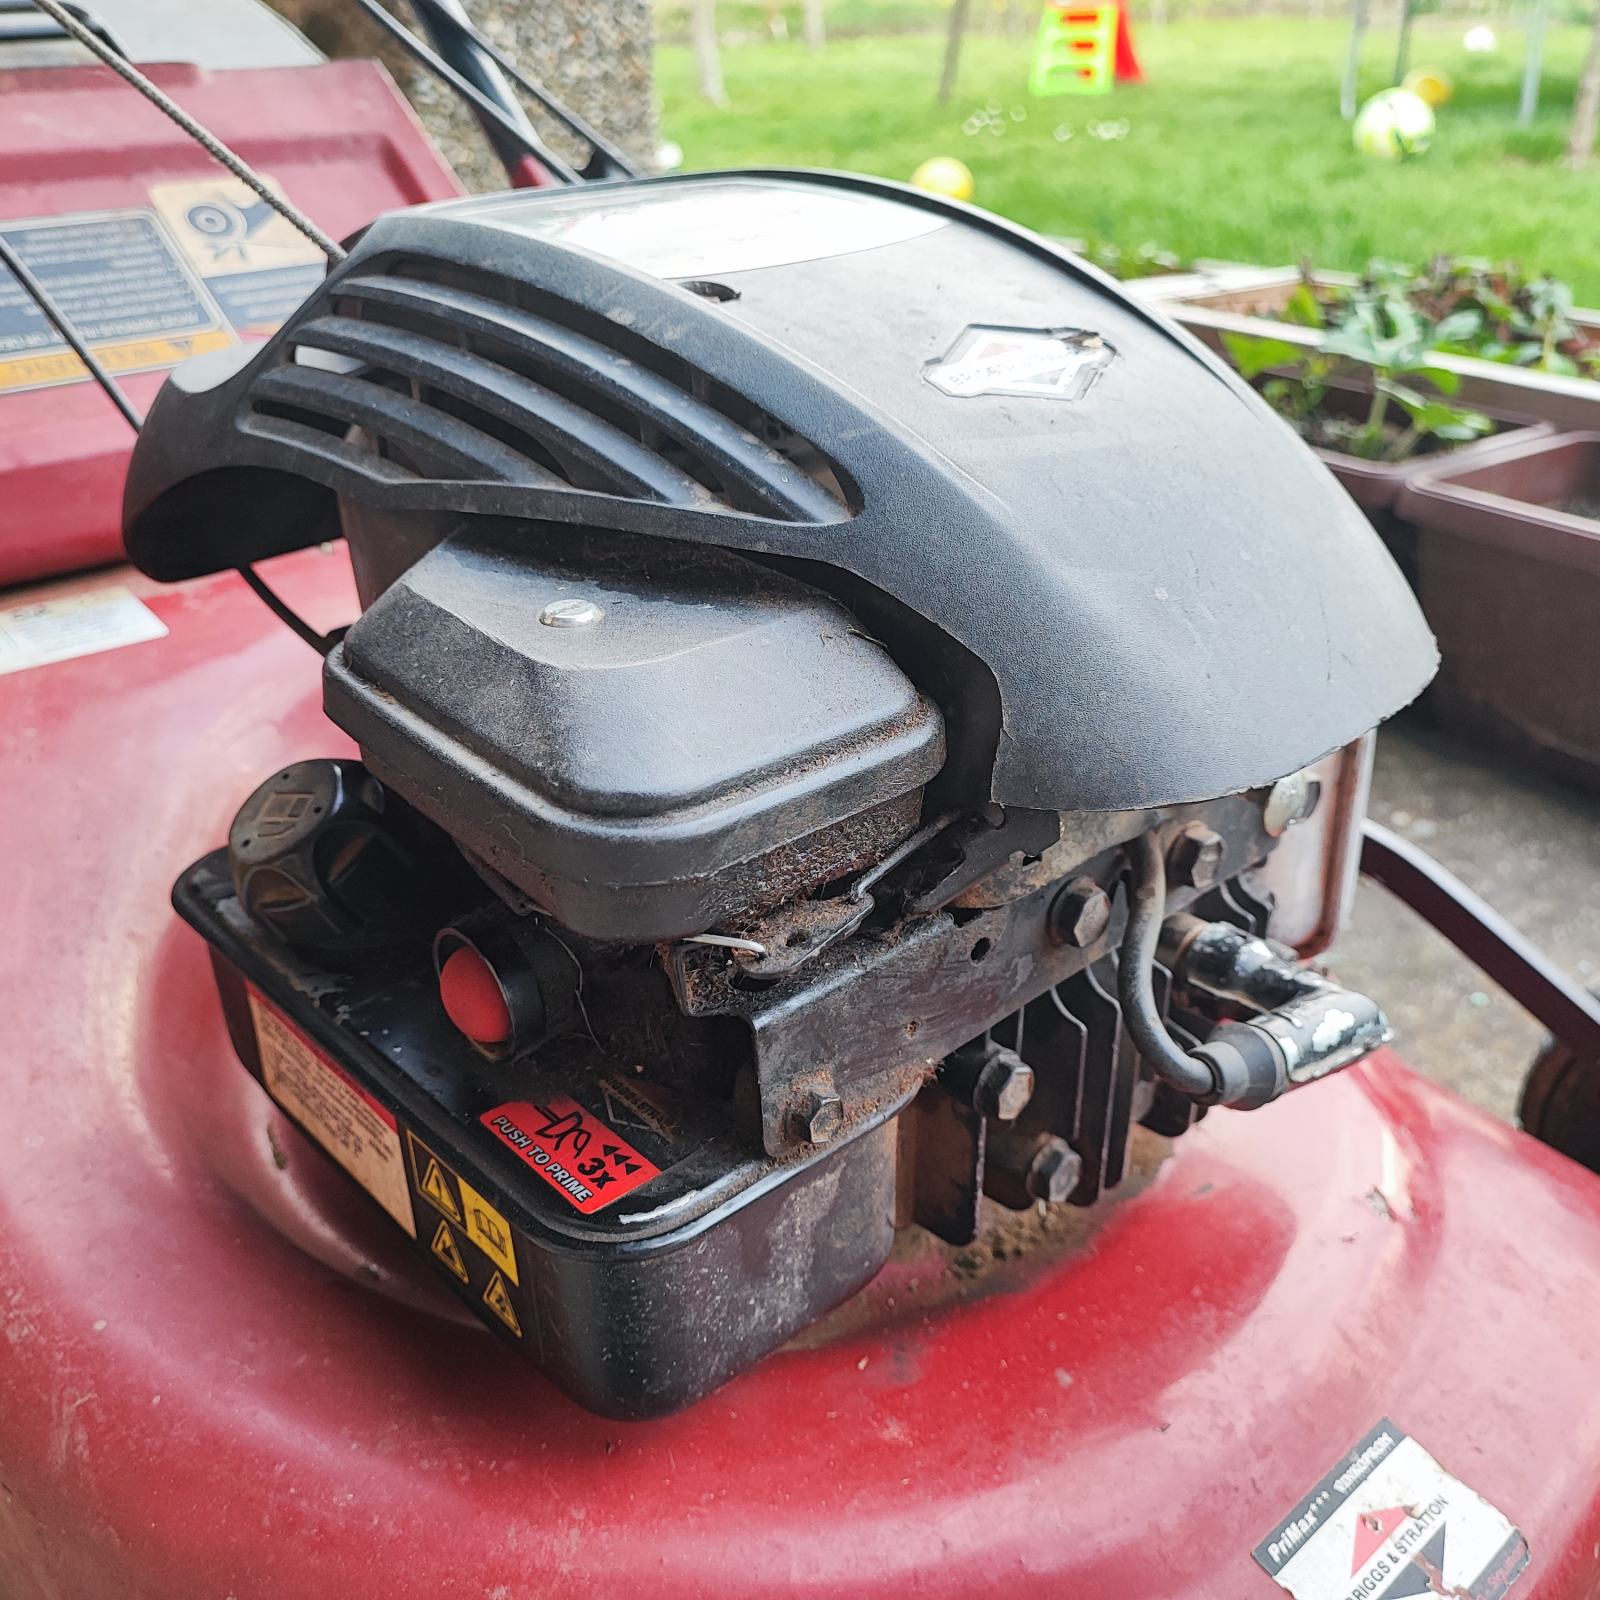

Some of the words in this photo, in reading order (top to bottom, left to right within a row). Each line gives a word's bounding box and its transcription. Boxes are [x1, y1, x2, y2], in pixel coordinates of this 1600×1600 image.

[492, 1115, 531, 1148] PUSH
[528, 1145, 550, 1166] TO
[545, 1163, 593, 1202] PRIME
[1386, 1552, 1400, 1564] &
[1394, 1494, 1450, 1554] STRATTON
